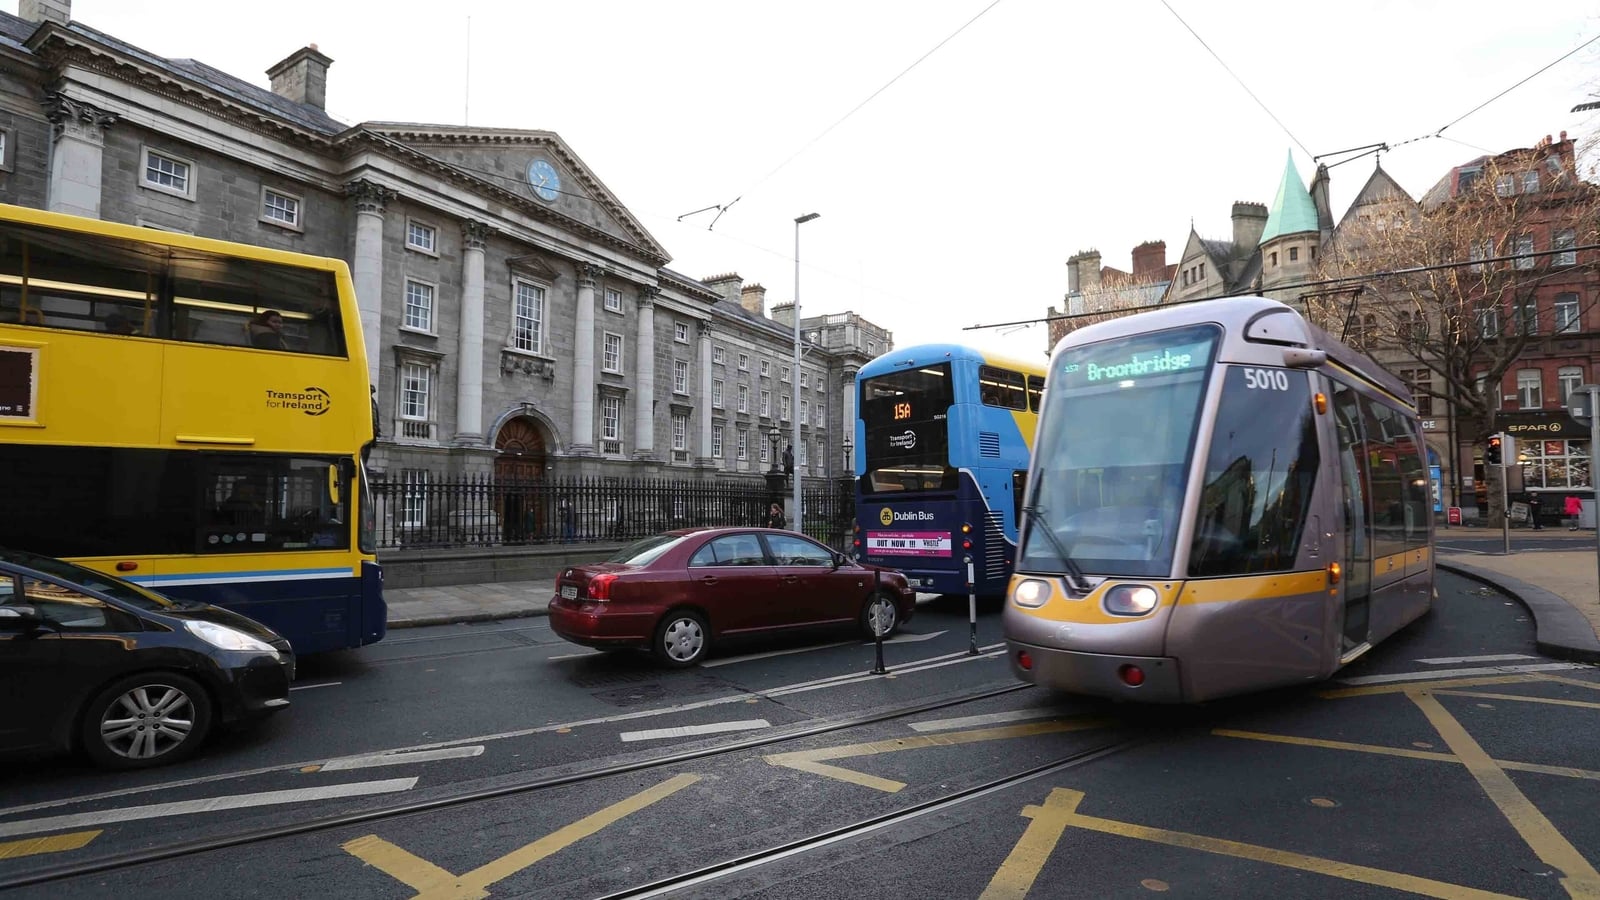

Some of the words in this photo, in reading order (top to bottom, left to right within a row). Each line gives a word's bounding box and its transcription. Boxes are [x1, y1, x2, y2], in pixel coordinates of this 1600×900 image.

[1243, 367, 1289, 391] 5010
[266, 390, 322, 401] Transport
[266, 400, 281, 409] for
[282, 401, 322, 410] Ireland
[894, 402, 911, 420] 15A
[1422, 420, 1436, 429] CE
[1508, 424, 1548, 432] SPAR
[893, 511, 918, 521] Dublin
[918, 511, 934, 521] Bus
[876, 539, 889, 547] OUT
[891, 540, 906, 548] NOW
